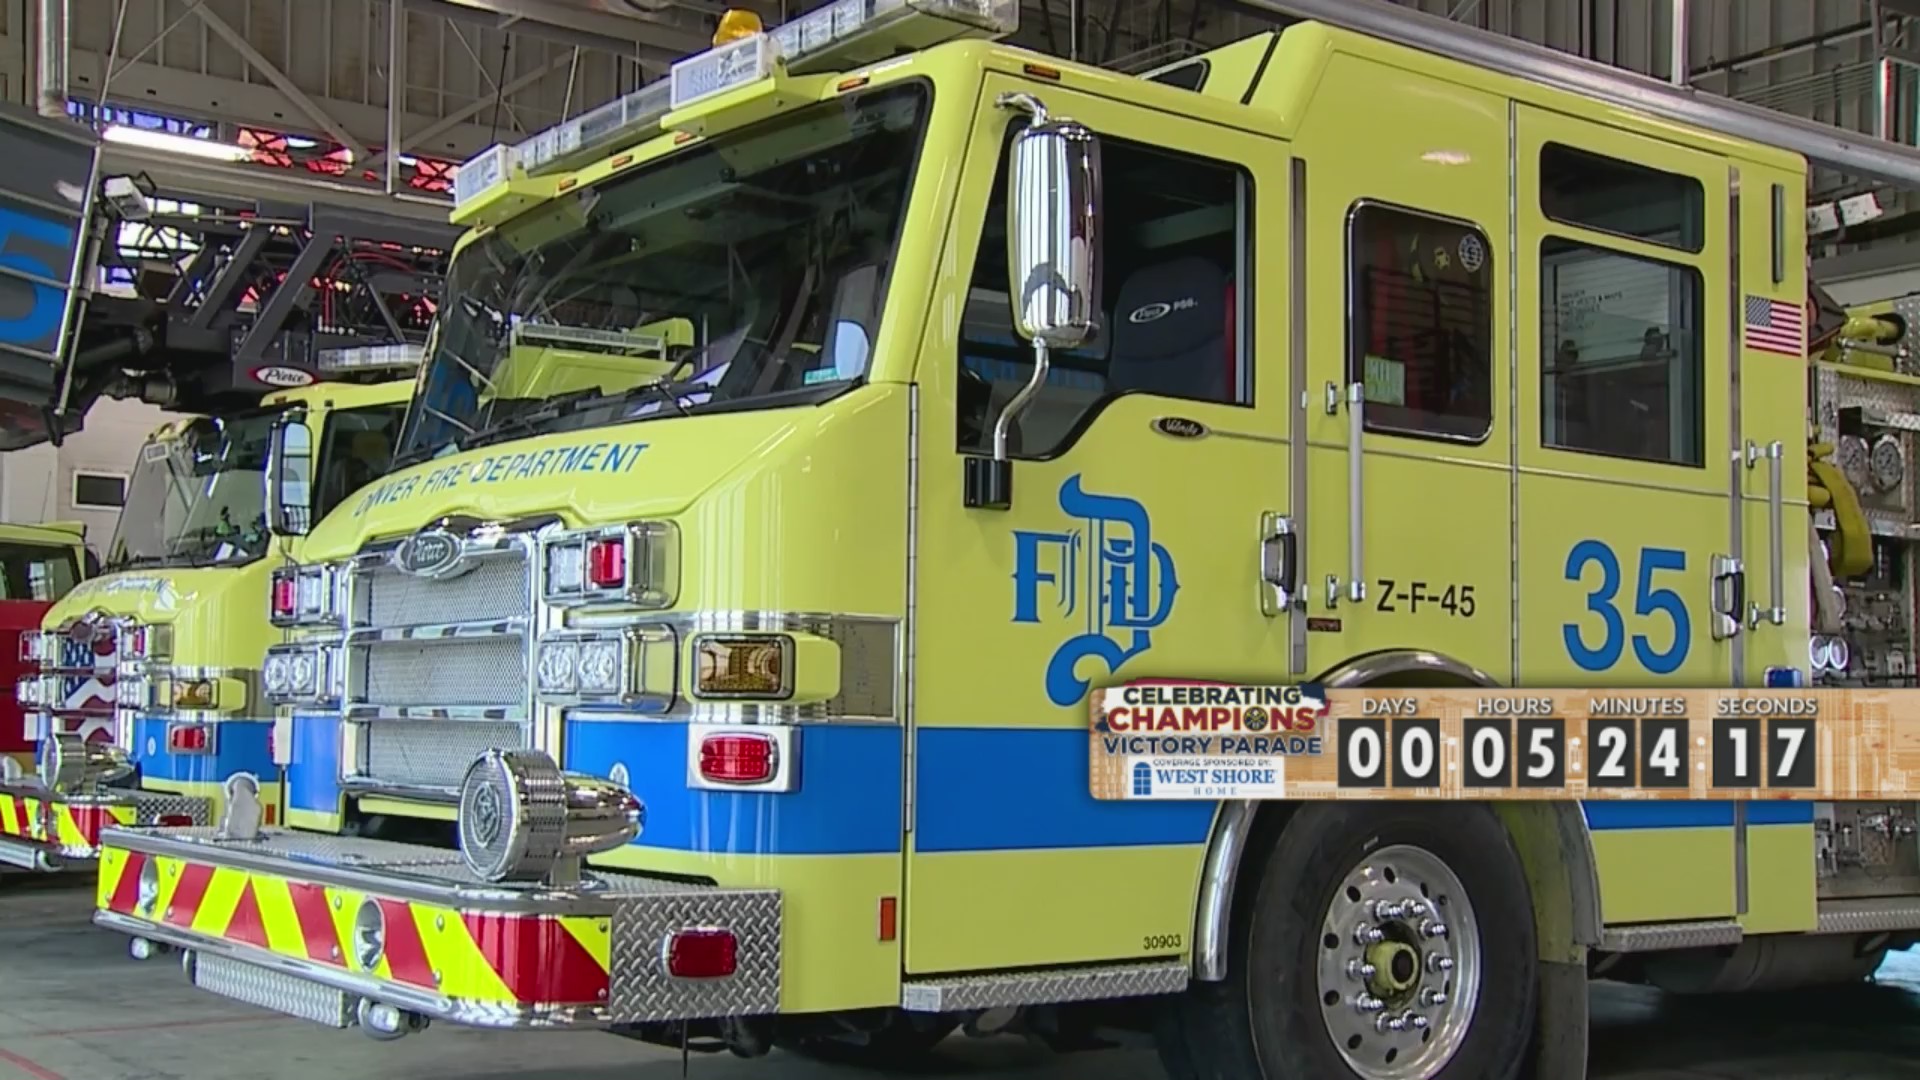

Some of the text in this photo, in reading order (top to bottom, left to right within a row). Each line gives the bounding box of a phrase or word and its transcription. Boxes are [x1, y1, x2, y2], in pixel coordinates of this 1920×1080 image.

[420, 461, 471, 496] FIRE
[468, 443, 649, 484] DEPARTMENT
[1376, 579, 1476, 617] Z-F-45
[1562, 539, 1691, 675] 35
[1143, 933, 1182, 950] 30903
